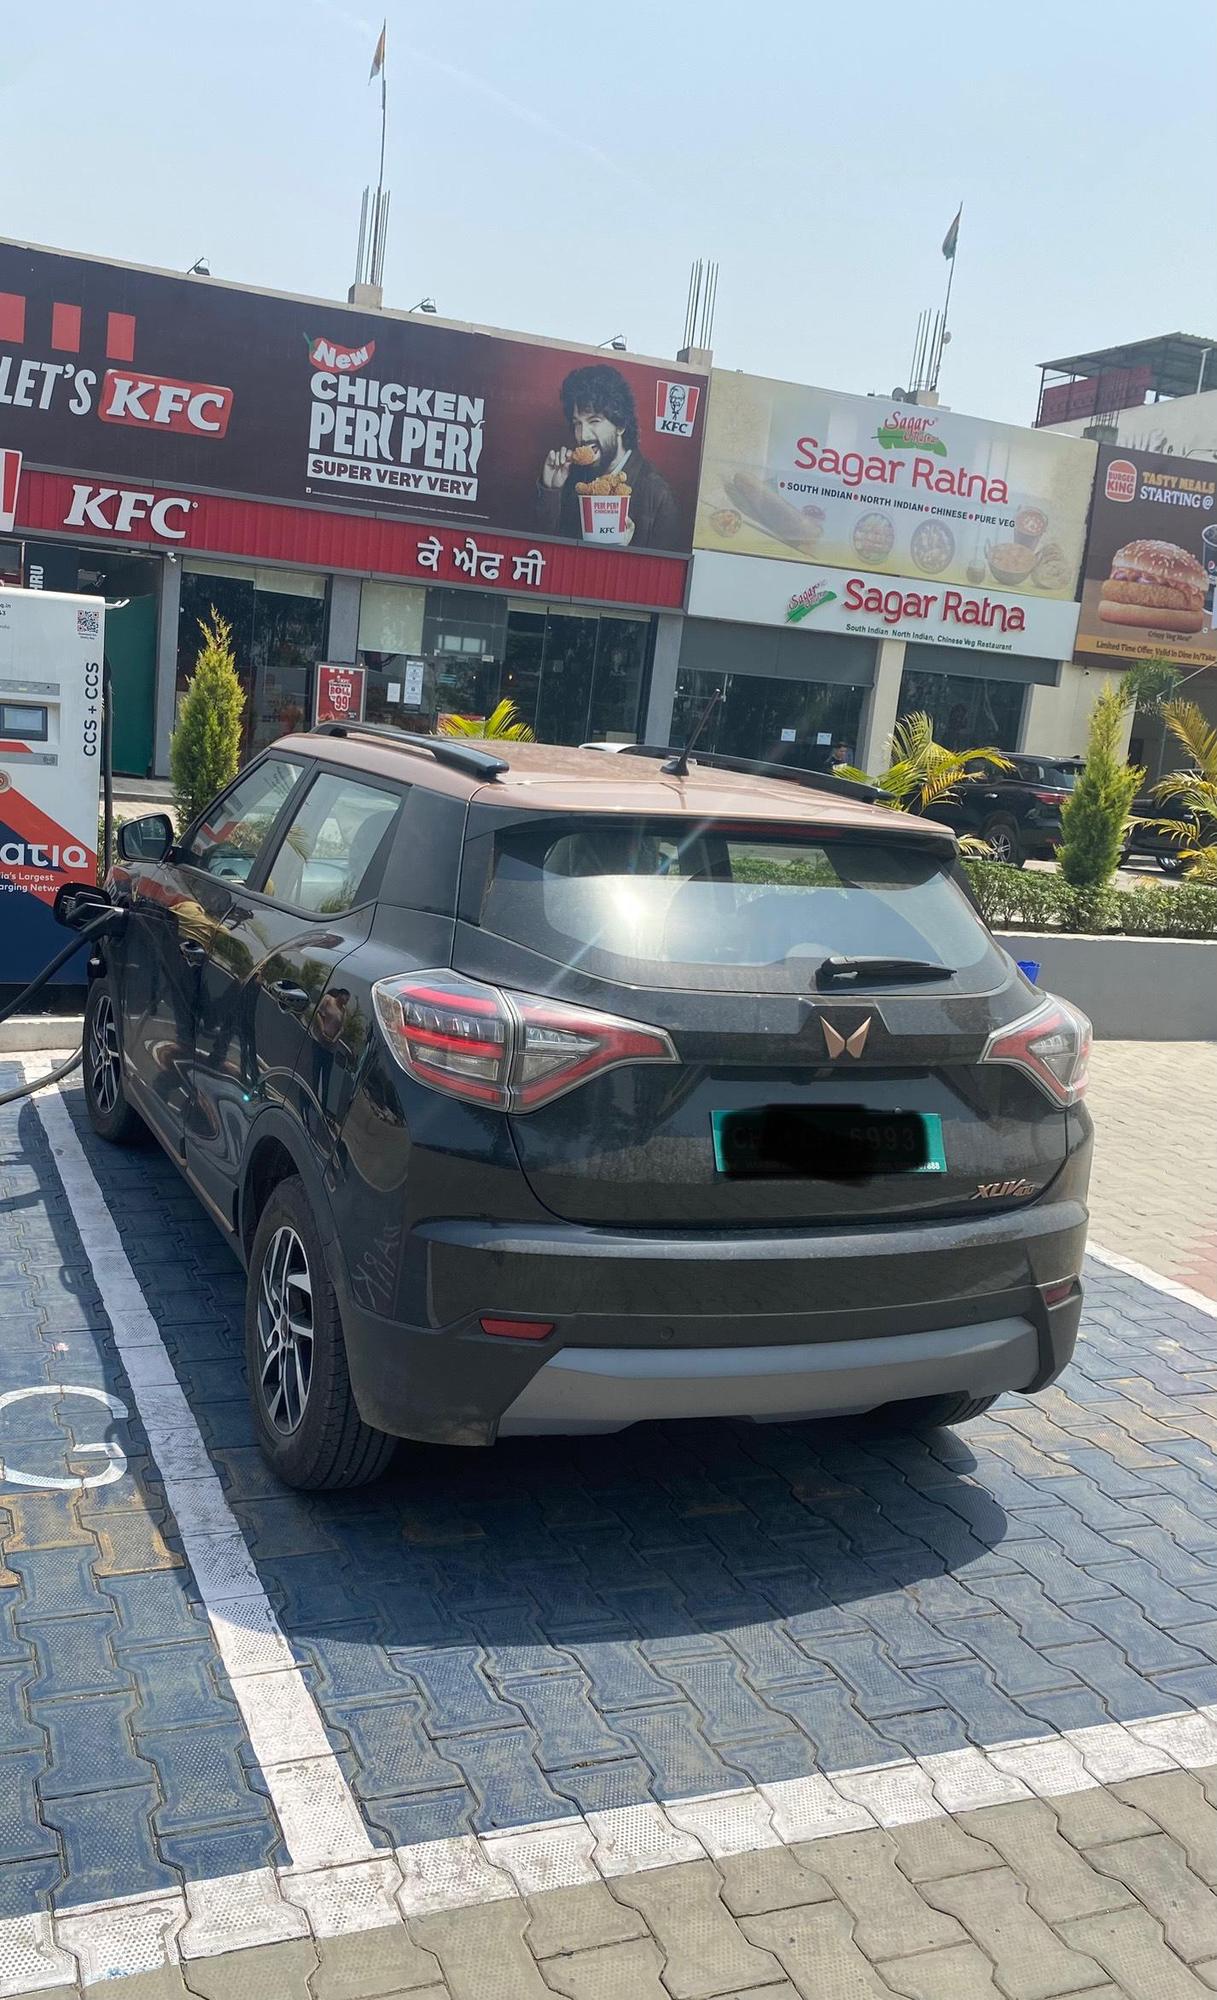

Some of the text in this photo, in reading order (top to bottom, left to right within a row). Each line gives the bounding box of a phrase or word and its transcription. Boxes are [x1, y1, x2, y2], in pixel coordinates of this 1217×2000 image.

[313, 340, 369, 369] New
[0, 356, 225, 431] LET'S KFC
[310, 371, 485, 424] CHICKEN
[309, 402, 486, 474] PERI PERI
[661, 420, 688, 434] KFC
[311, 459, 473, 496] SUPER VERY VERY
[794, 437, 1009, 504] Sagar Ratna
[1107, 471, 1135, 494] BURGER KING
[1142, 471, 1216, 494] TASTY MEALS
[63, 484, 191, 539] KFC
[787, 482, 1015, 528] SOUTH INDIAN NORTH INDIAN CHINESE PURE VEG
[1140, 486, 1201, 508] STARTING
[30, 565, 44, 590] HRU
[417, 535, 444, 572] ਕੇ
[512, 549, 546, 586] ਸੀ
[843, 578, 937, 624] Sagar
[943, 590, 1026, 633] Ratna
[845, 623, 866, 633] South
[867, 626, 889, 635] Indian
[892, 630, 911, 638] North
[937, 635, 963, 645] Chinese
[976, 640, 1012, 651] Restaurant
[1096, 640, 1120, 651] Limited
[85, 662, 99, 700] CCS
[83, 720, 97, 757] CCS
[19, 872, 55, 883] Largest
